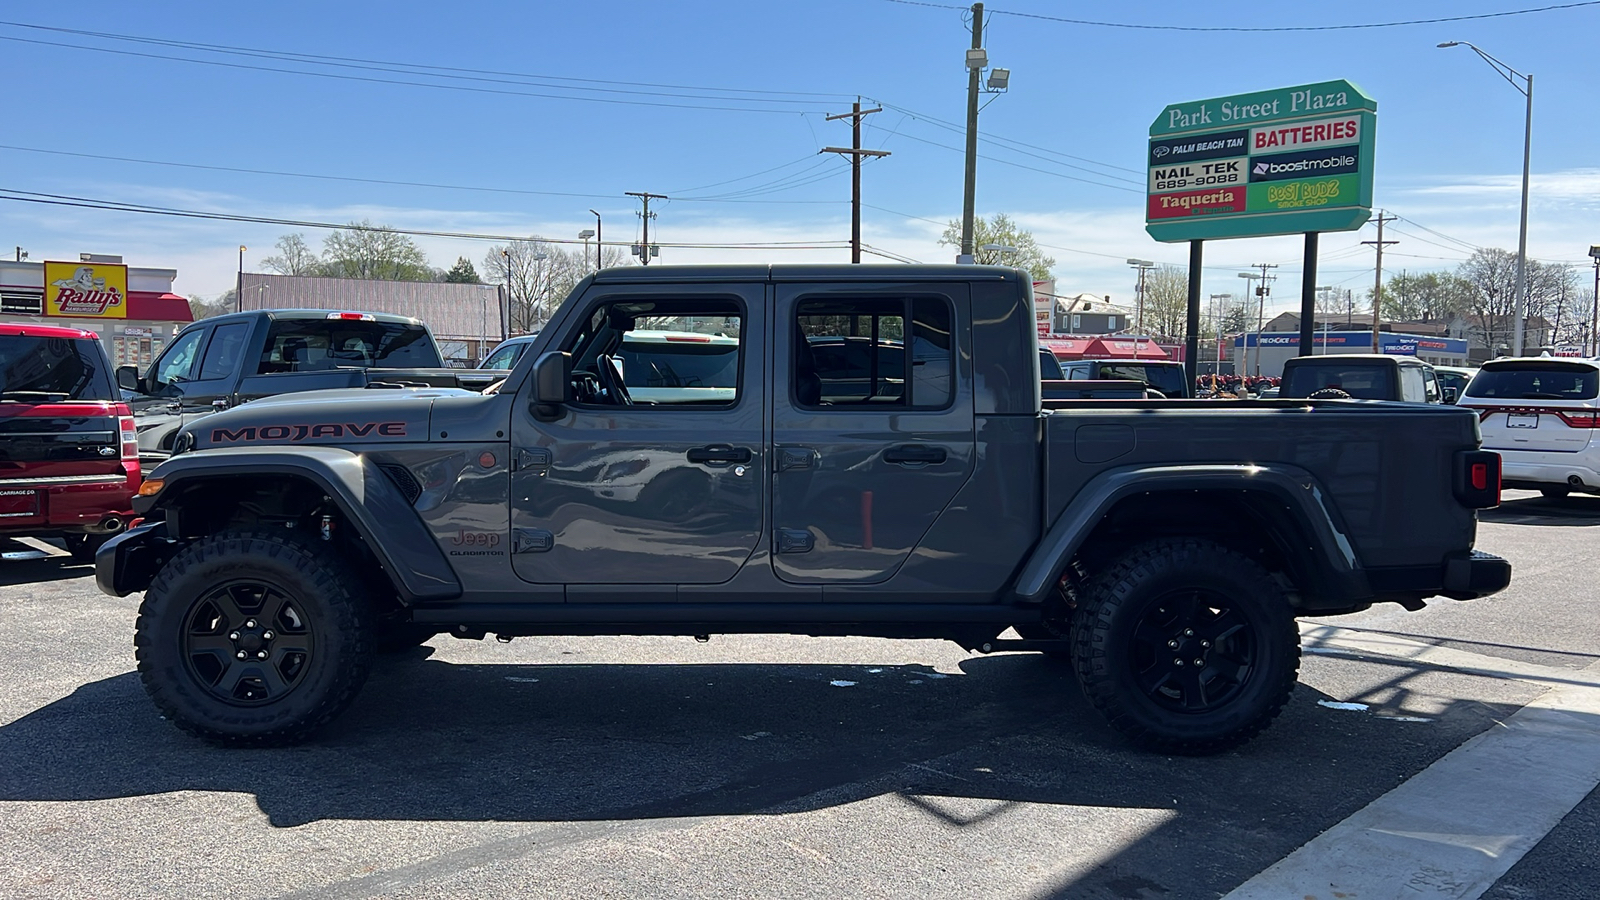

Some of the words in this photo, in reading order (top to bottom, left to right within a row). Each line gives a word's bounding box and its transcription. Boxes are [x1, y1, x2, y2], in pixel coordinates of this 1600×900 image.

[1168, 104, 1213, 129] Park
[1221, 98, 1280, 122] Street
[1289, 89, 1348, 112] Plaza
[1255, 120, 1357, 149] BATTERIES
[1172, 143, 1195, 154] PALM
[1196, 140, 1225, 152] BEACH
[1226, 137, 1244, 148] TAN
[1154, 167, 1194, 181] NAIL
[1201, 161, 1240, 175] TEK
[1156, 173, 1238, 190] 689-9088
[1306, 198, 1328, 206] SHOP
[53, 286, 122, 313] Rally's
[211, 421, 407, 443] MOJAVE
[452, 529, 500, 549] Jeep
